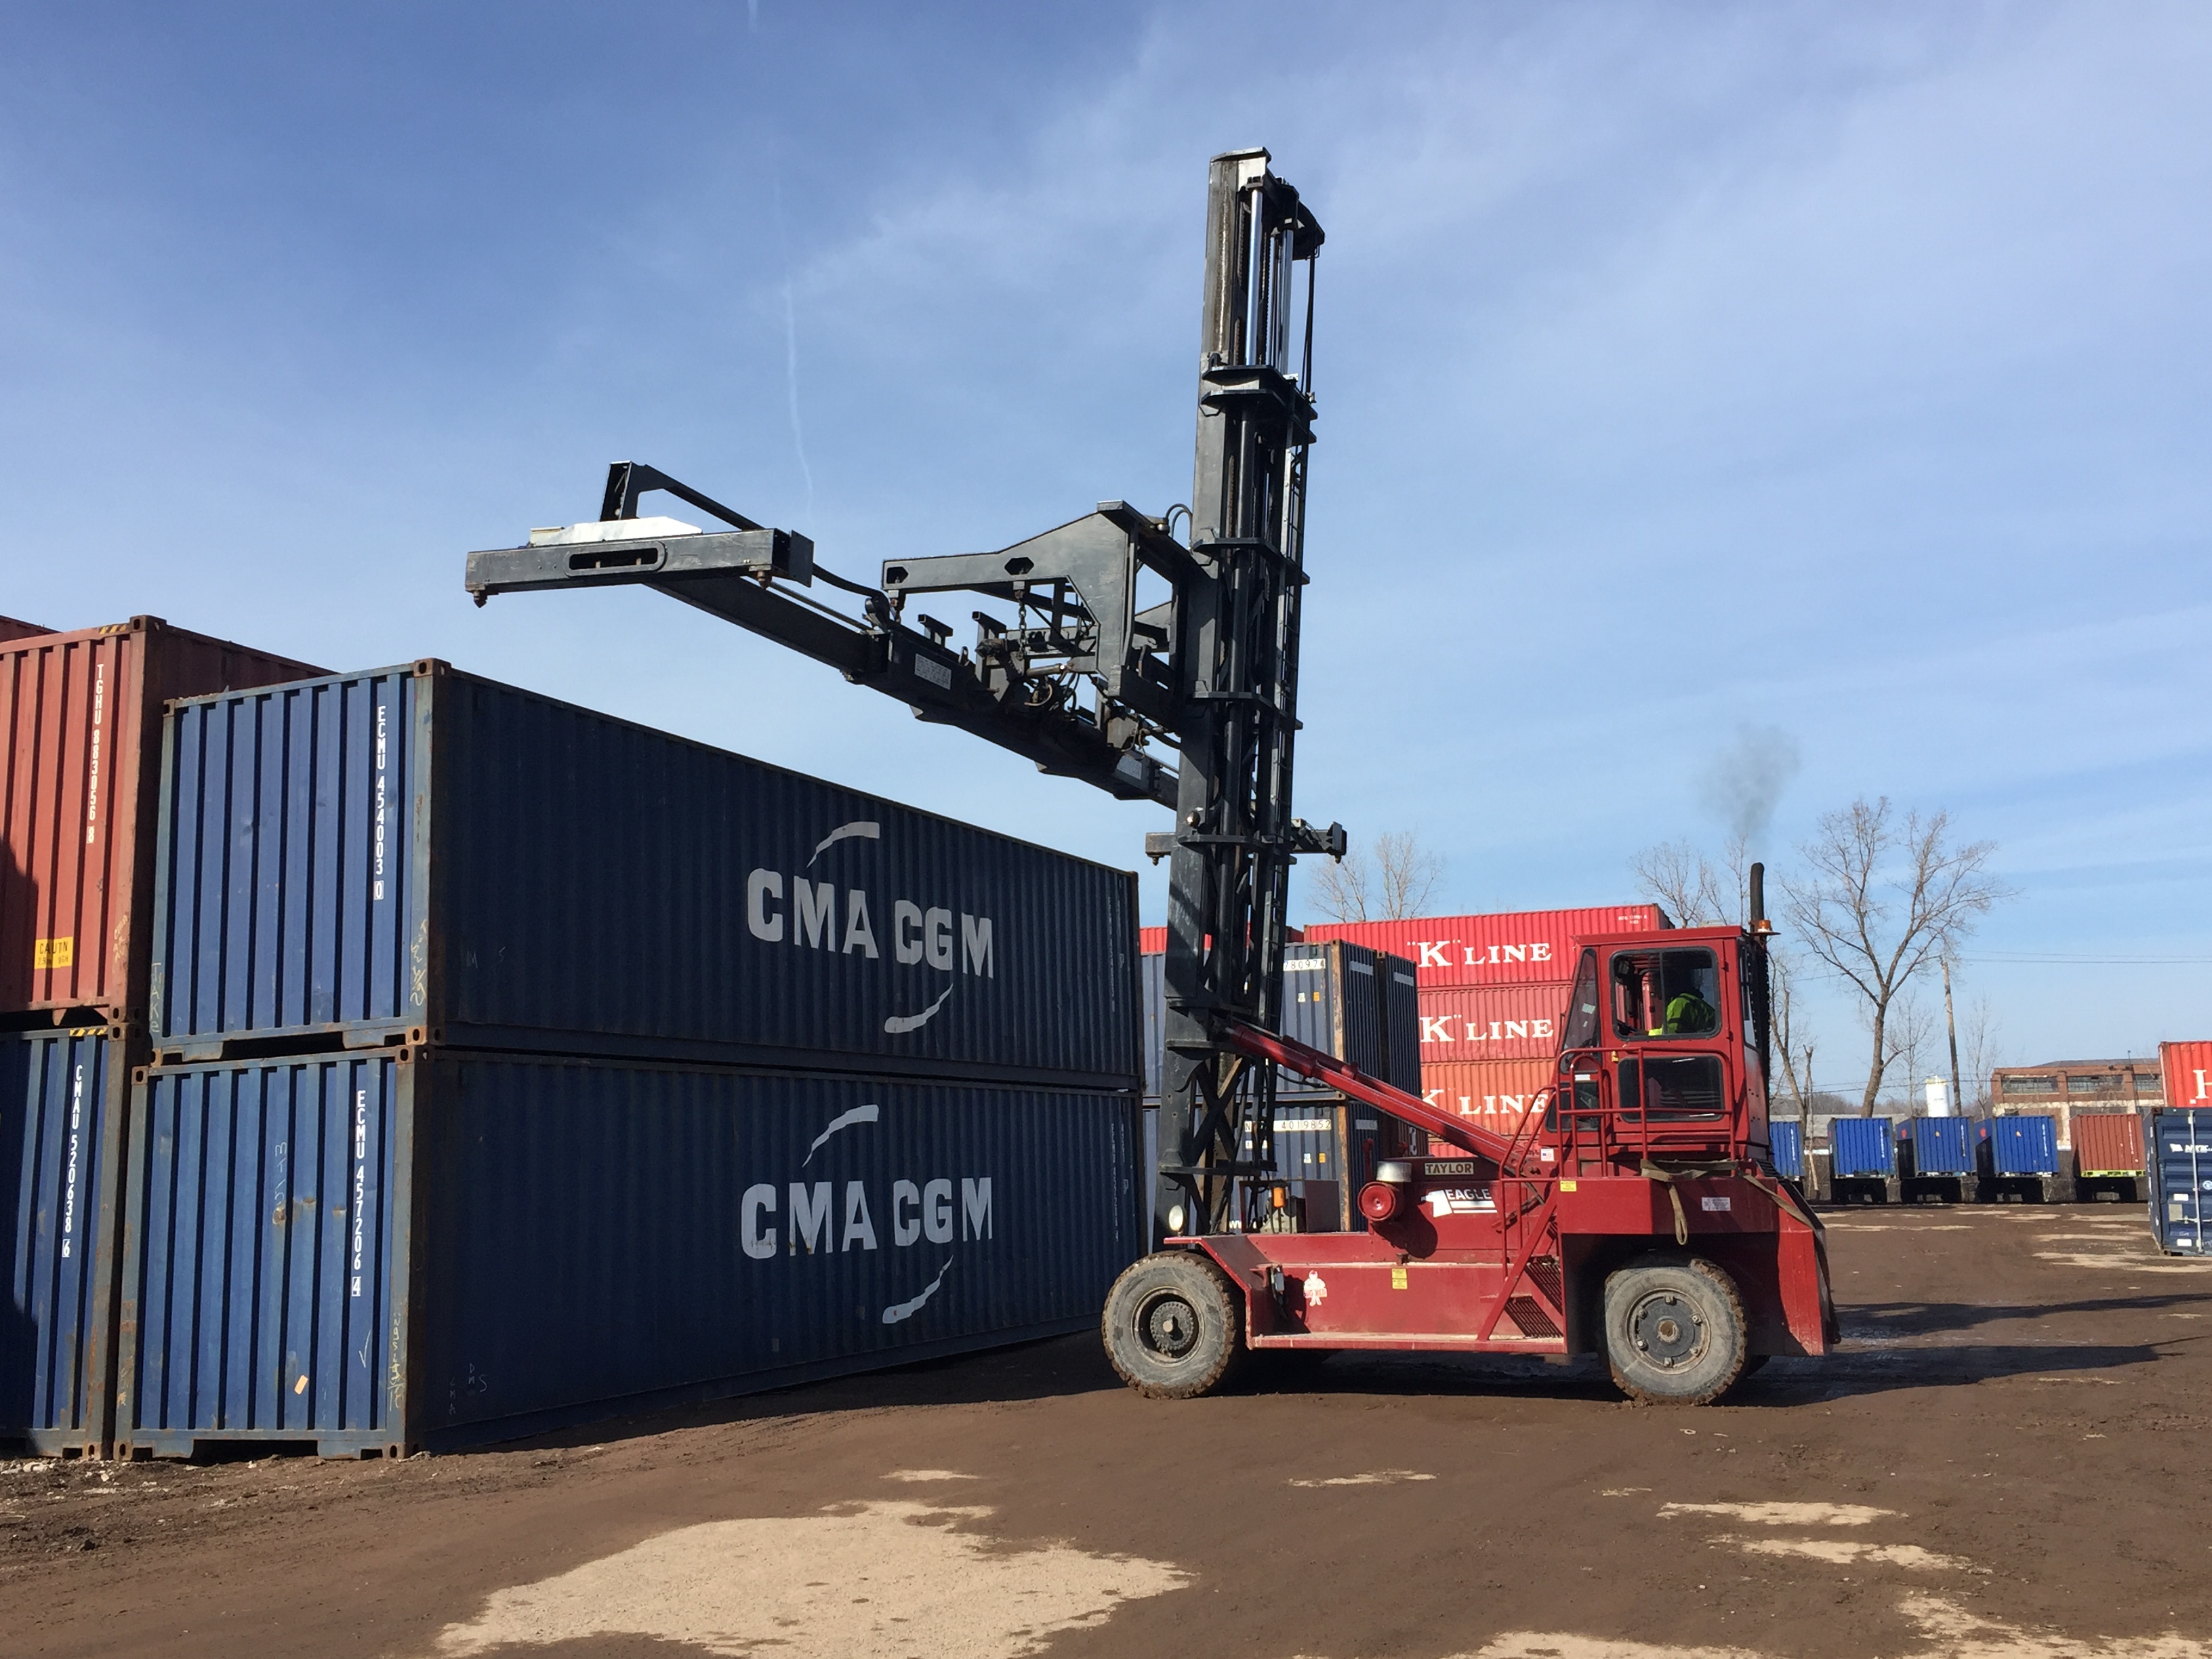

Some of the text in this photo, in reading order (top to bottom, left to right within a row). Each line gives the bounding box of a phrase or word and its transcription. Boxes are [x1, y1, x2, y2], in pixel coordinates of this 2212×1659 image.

[86, 663, 104, 844] TGHU 883056 8
[374, 705, 386, 900] ECMU 454003 0
[747, 868, 994, 979] CMA CGM
[1464, 943, 1552, 965] LINE
[1466, 1019, 1554, 1041] LINE
[1459, 1094, 1549, 1115] LINE
[62, 1064, 83, 1258] CMAU 520638 6
[351, 1090, 366, 1296] ECMU 457206 4
[1426, 1164, 1472, 1174] TAYLOR
[1445, 1189, 1492, 1200] EAGLE
[741, 1176, 993, 1259] CMA CGM
